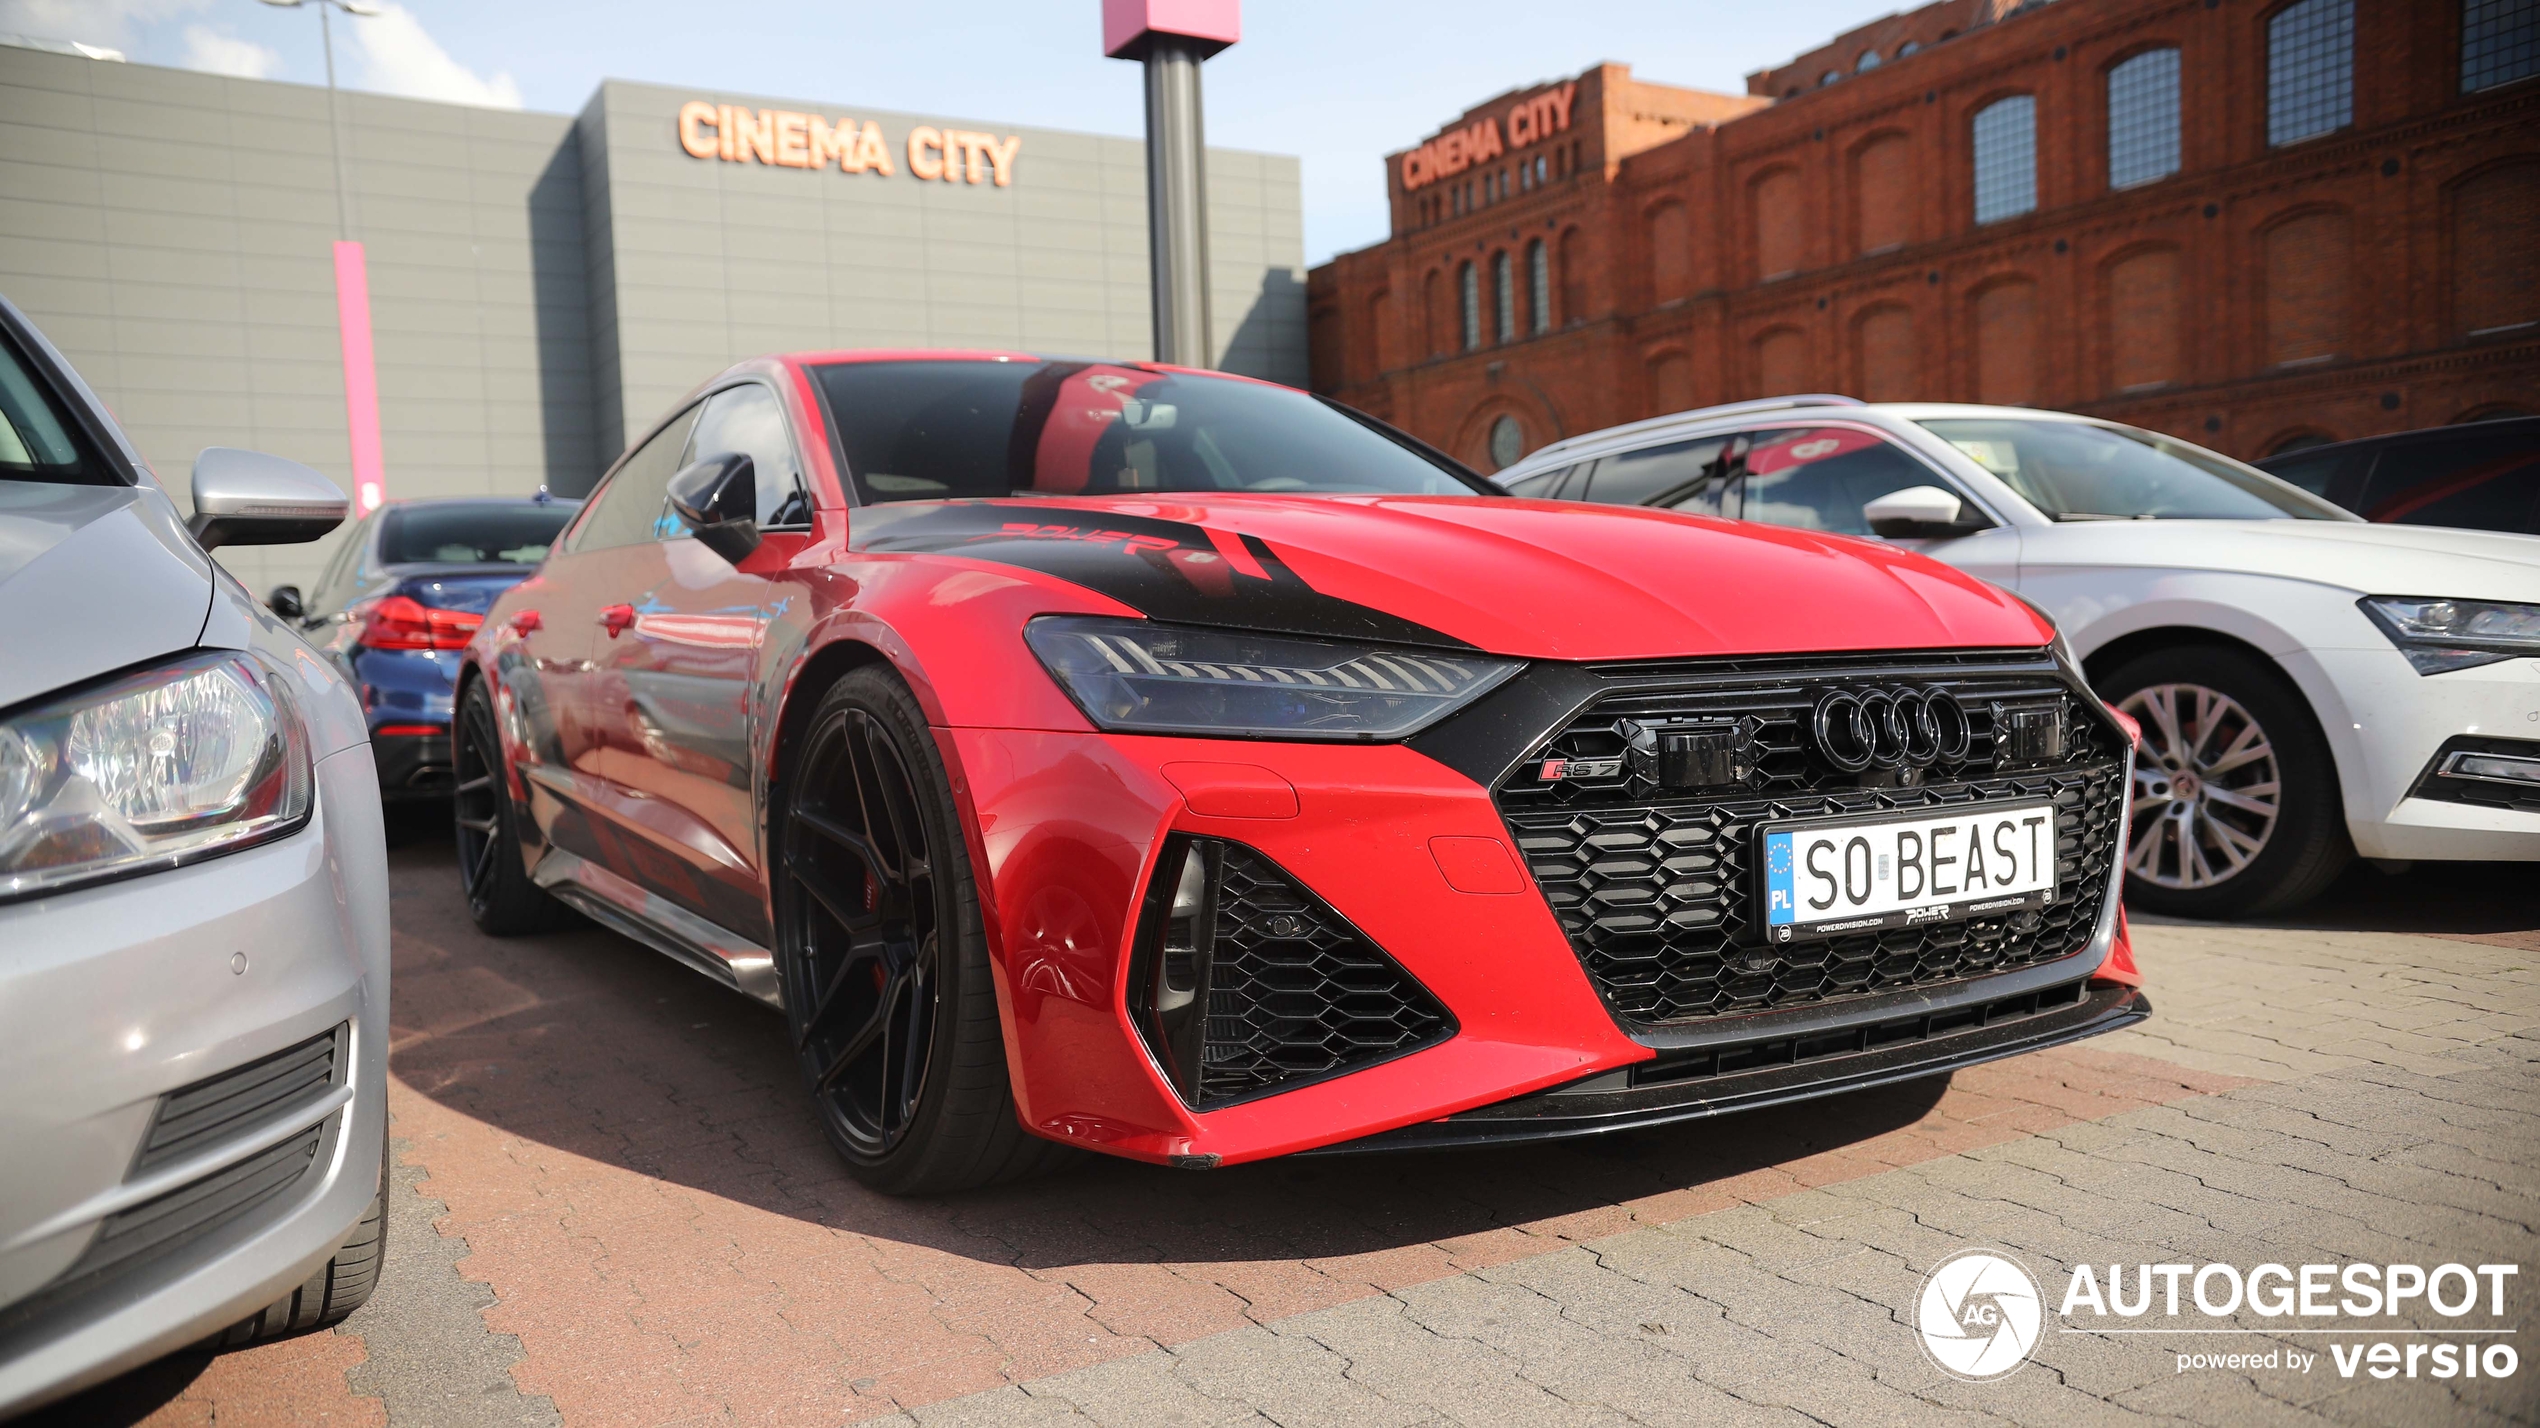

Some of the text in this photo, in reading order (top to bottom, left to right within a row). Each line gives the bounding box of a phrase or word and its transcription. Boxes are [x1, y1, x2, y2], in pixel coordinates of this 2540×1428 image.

[679, 100, 1022, 187] CINEMA CITY
[1402, 82, 1577, 191] CINEMA CITY
[1897, 816, 2046, 901] BEAST
[1771, 889, 1792, 911] PL
[1969, 896, 2026, 912] POWERDIVISION.COM
[1816, 917, 1884, 934] POWERDIVISION.COM
[1905, 904, 1950, 926] POWER
[1914, 915, 1943, 925] DIVISION
